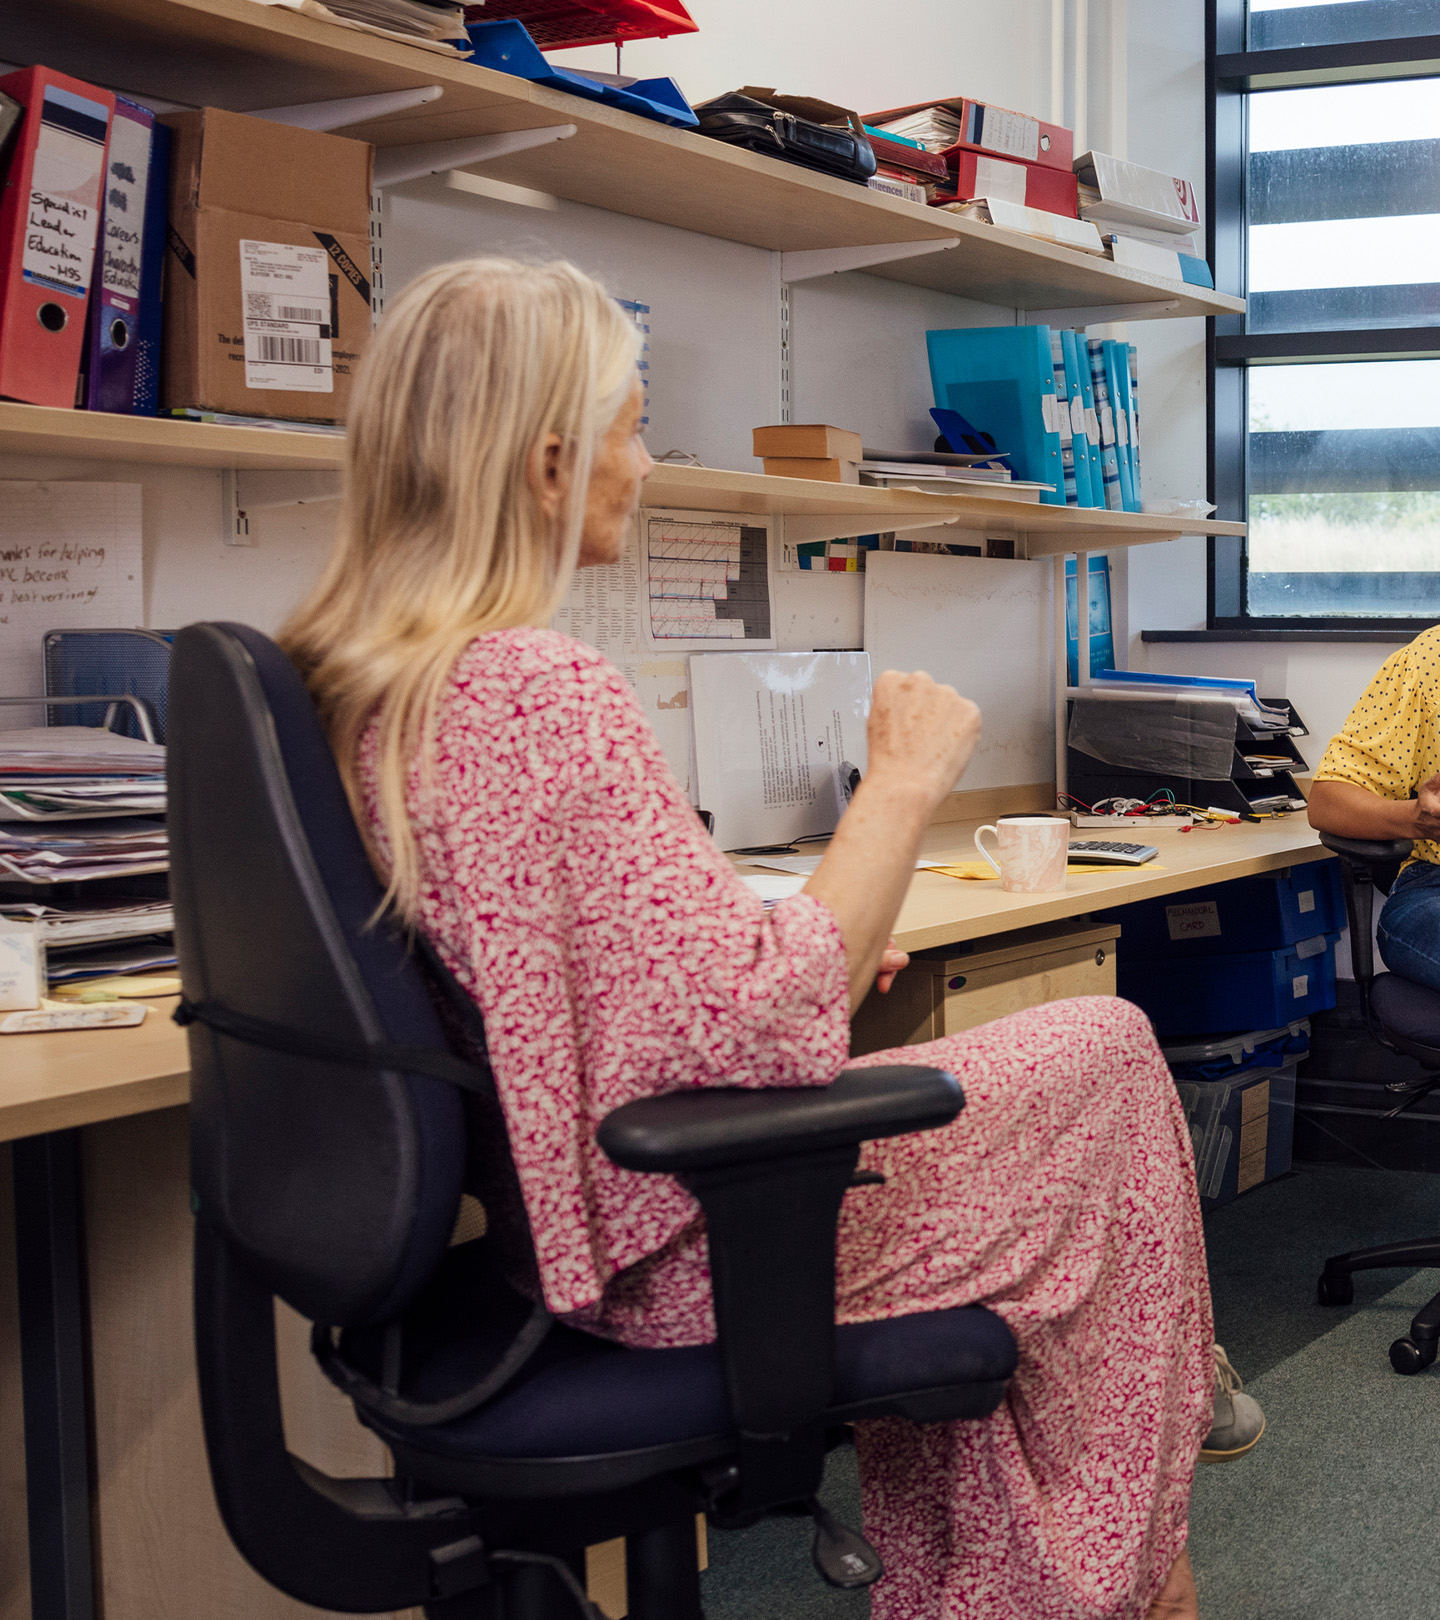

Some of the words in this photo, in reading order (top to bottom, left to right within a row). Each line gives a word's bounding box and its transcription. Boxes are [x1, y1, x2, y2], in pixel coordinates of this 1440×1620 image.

[868, 179, 903, 197] lligences
[30, 212, 76, 238] Leader
[28, 235, 82, 262] Education
[328, 243, 341, 257] 12
[337, 254, 363, 285] COPIES
[260, 321, 289, 329] STANDARD
[218, 333, 231, 344] The
[38, 541, 57, 559] for
[59, 542, 105, 568] helping
[22, 566, 70, 584] become
[10, 589, 37, 605] best
[1179, 921, 1205, 931] CARD
